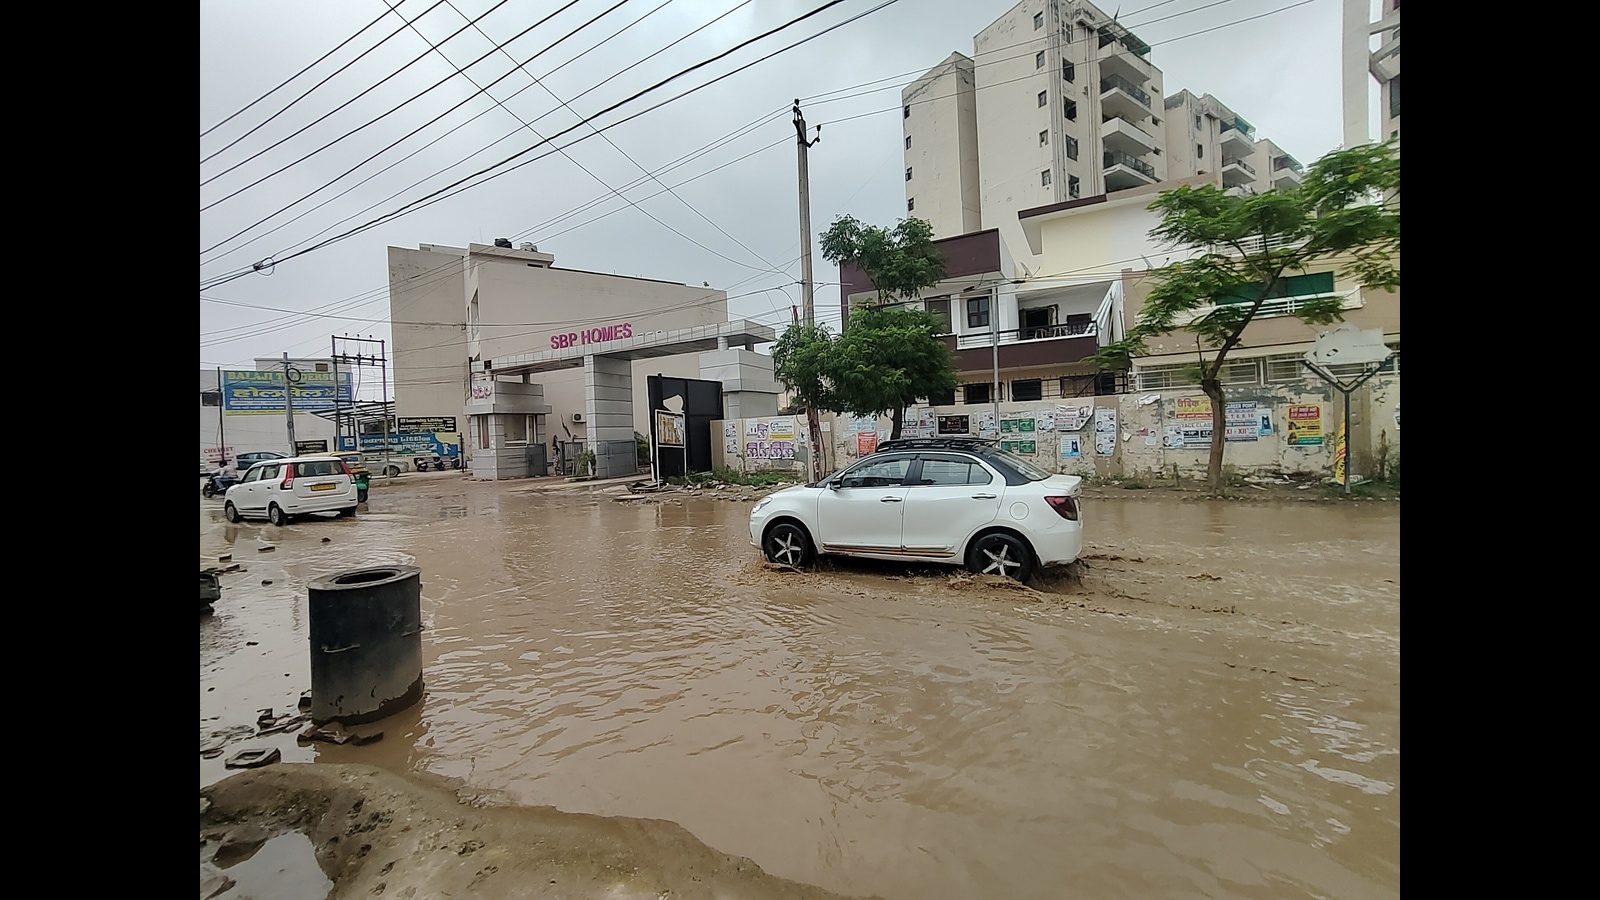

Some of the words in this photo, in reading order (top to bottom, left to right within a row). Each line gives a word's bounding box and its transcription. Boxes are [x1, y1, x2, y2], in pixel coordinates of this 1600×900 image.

[550, 332, 577, 349] SBP
[581, 322, 632, 345] HOMES
[228, 372, 273, 380] BALAJI
[276, 373, 329, 381] TADERS
